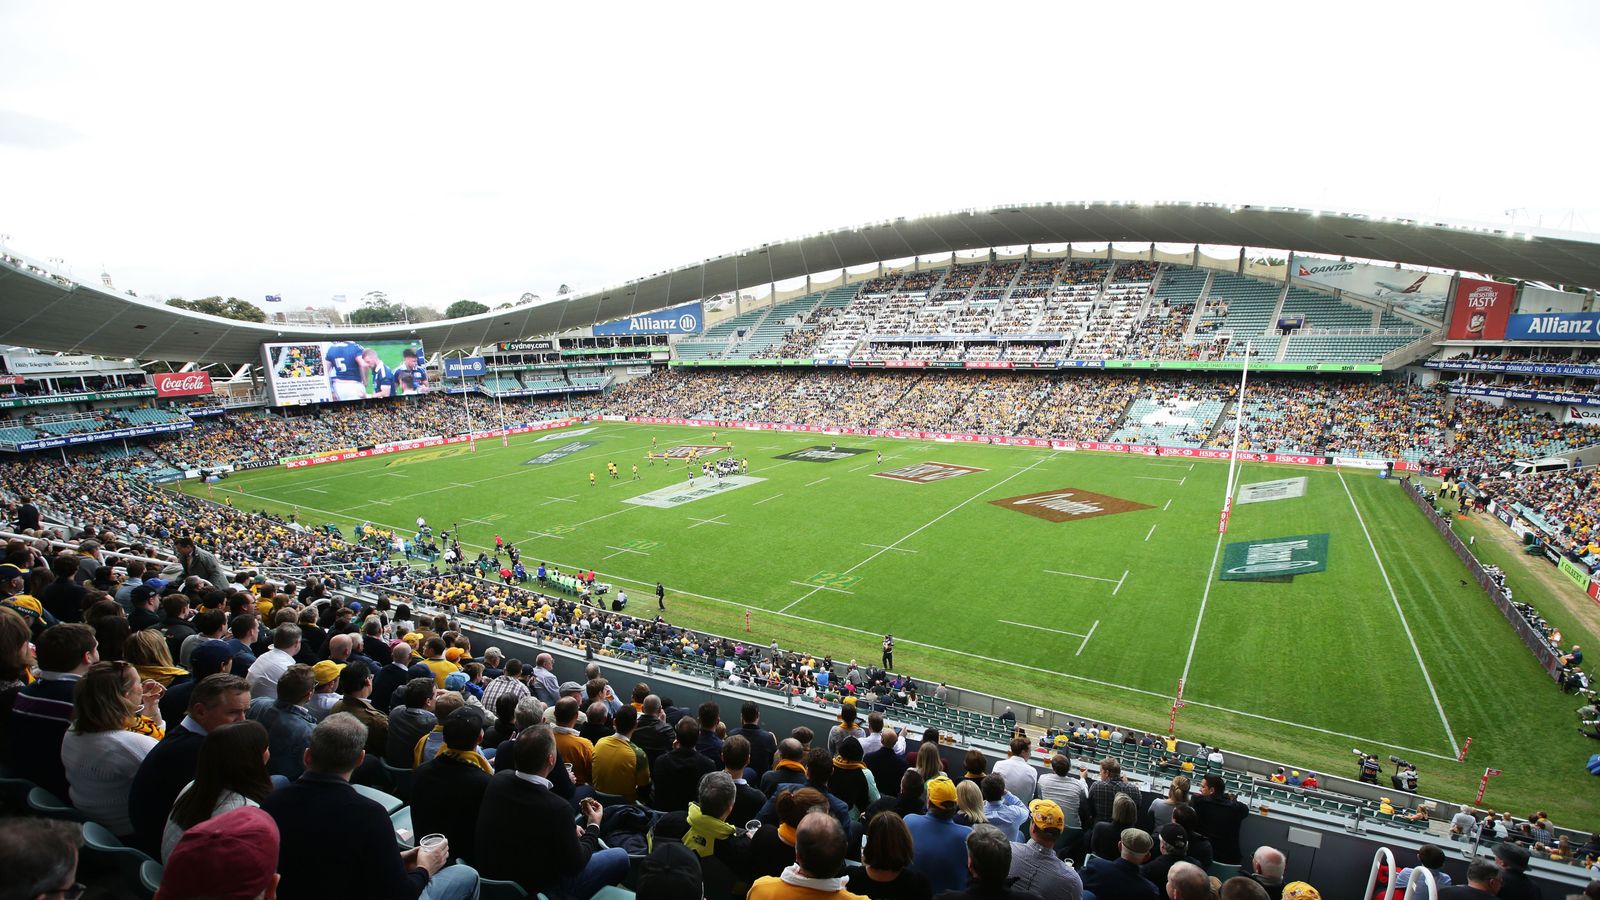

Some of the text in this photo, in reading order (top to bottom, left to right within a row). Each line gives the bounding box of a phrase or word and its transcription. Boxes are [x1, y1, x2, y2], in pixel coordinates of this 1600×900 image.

[1310, 263, 1355, 275] QANTAS
[1468, 297, 1497, 308] TASTY
[629, 317, 677, 331] Allianz
[1527, 316, 1593, 334] Allianz
[510, 342, 550, 351] sydney.com
[334, 357, 347, 373] 5
[1505, 364, 1534, 372] DOWNLOAD
[1563, 367, 1585, 375] ALLIANZ
[161, 375, 205, 393] Coca-Cola
[101, 389, 156, 400] VICTORIA BITTER
[1536, 393, 1555, 401] Allianz
[1561, 395, 1582, 403] Stadium
[28, 397, 64, 405] VICTORIA
[313, 456, 330, 464] HSBC
[343, 452, 359, 460] HSBC
[1096, 443, 1114, 451] HSBC
[1129, 445, 1148, 453] HSBC
[1163, 448, 1183, 456] HSBC
[1199, 450, 1219, 458] HSBC
[1236, 452, 1256, 460] HSBC
[1275, 455, 1298, 463] HSBC
[245, 459, 279, 469] TAYLORS
